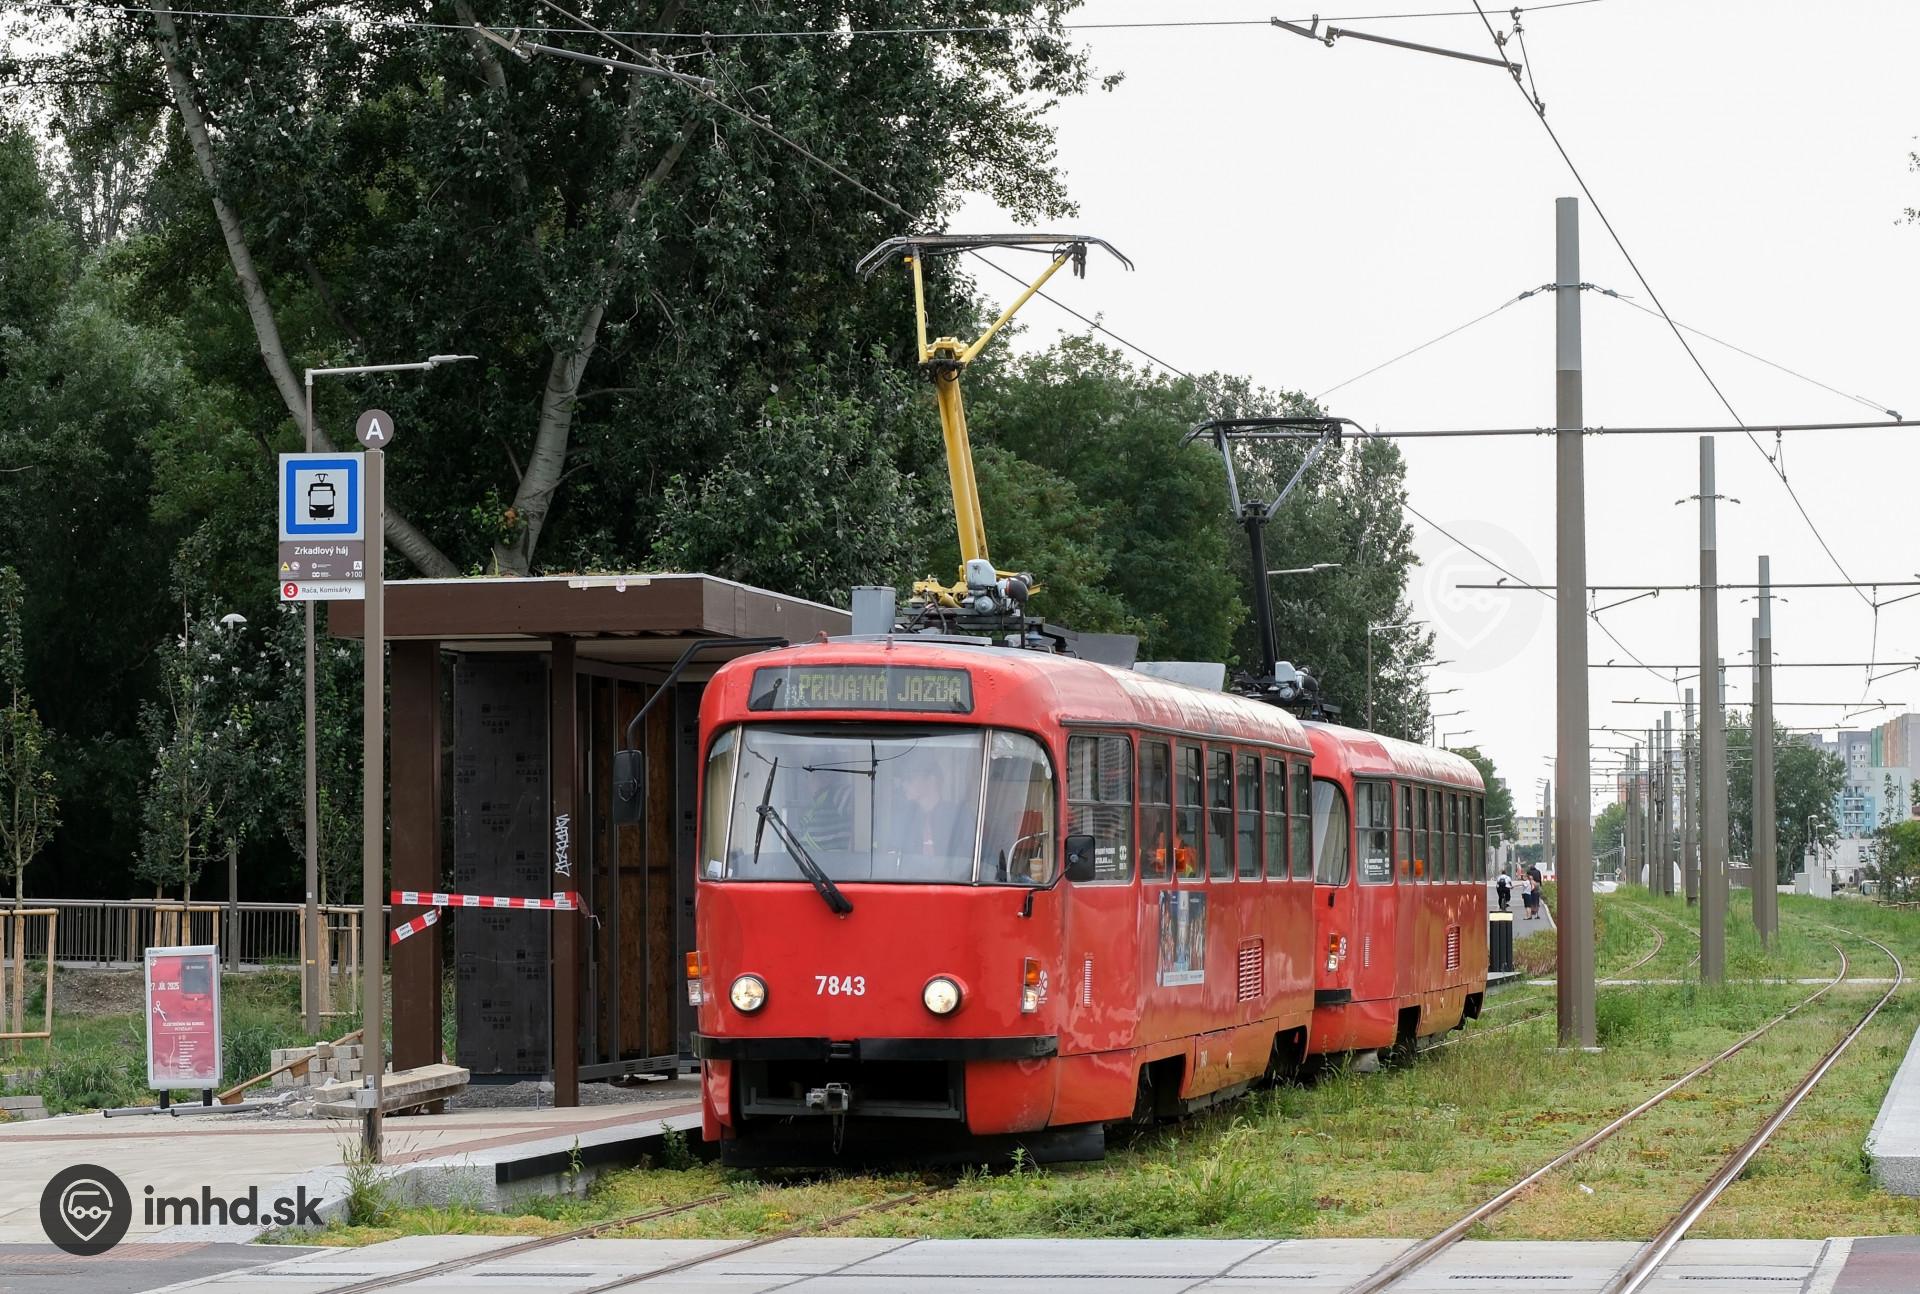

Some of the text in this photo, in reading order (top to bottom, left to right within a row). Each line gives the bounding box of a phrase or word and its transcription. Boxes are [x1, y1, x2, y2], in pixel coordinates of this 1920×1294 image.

[365, 417, 384, 440] A
[294, 545, 349, 556] Zrkadlový háj
[287, 585, 295, 596] 3
[897, 675, 961, 702] JAZDA
[815, 975, 866, 996] 7843
